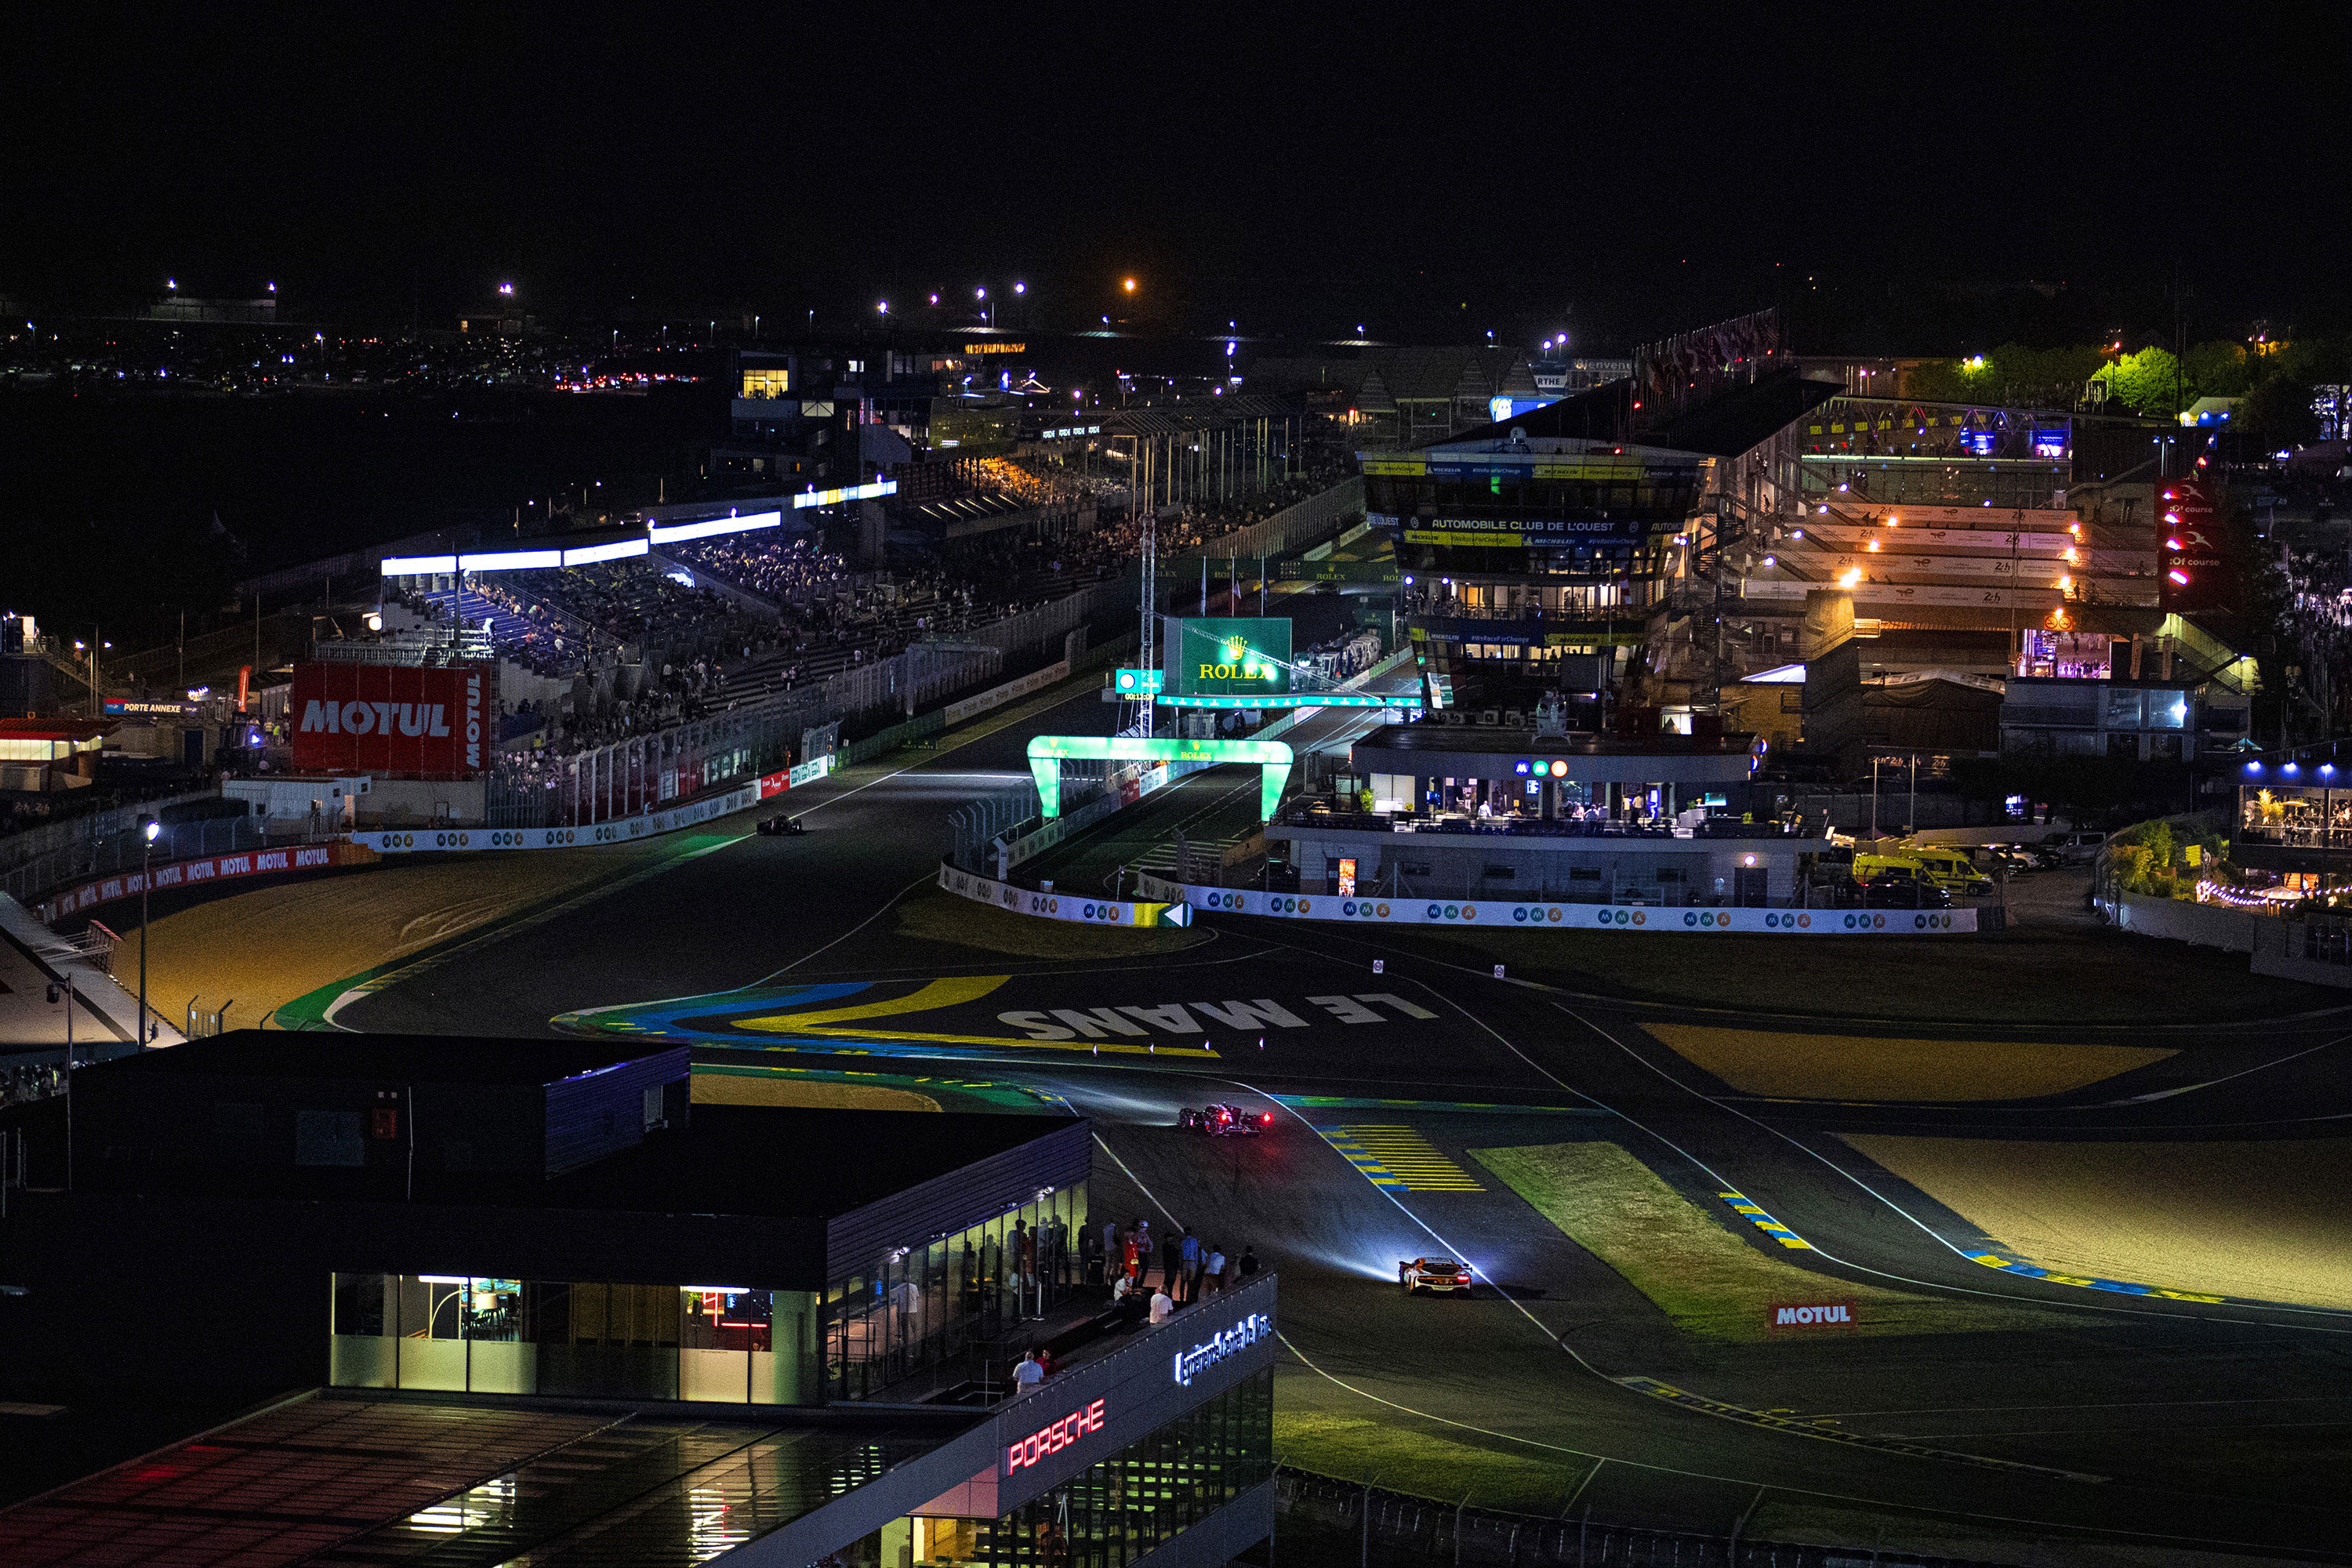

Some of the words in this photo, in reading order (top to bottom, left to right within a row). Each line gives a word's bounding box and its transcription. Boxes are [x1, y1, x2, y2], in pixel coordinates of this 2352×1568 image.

[1432, 519, 1507, 530] AUTOMOBILE
[1510, 521, 1544, 531] CLUB
[1547, 522, 1565, 532] DE
[1568, 522, 1615, 532] L'OUEST
[1199, 664, 1274, 680] ROLEX
[124, 703, 149, 712] PORTE
[149, 704, 181, 713] ANNEXE
[299, 699, 451, 738] MOTUL
[466, 673, 481, 768] MOTUL
[1180, 751, 1212, 760] ROLEX
[221, 856, 251, 875] MOTUL
[257, 852, 289, 870] MOTUL
[296, 848, 329, 866] MOTUL
[157, 866, 182, 887] MOTUL
[187, 862, 216, 880] MOTUL
[128, 873, 151, 893] MOTL
[1305, 993, 1440, 1025] LE
[996, 998, 1311, 1040] MANS
[1777, 1305, 1851, 1324] MOTUL
[1009, 1398, 1105, 1475] PORSCHE
